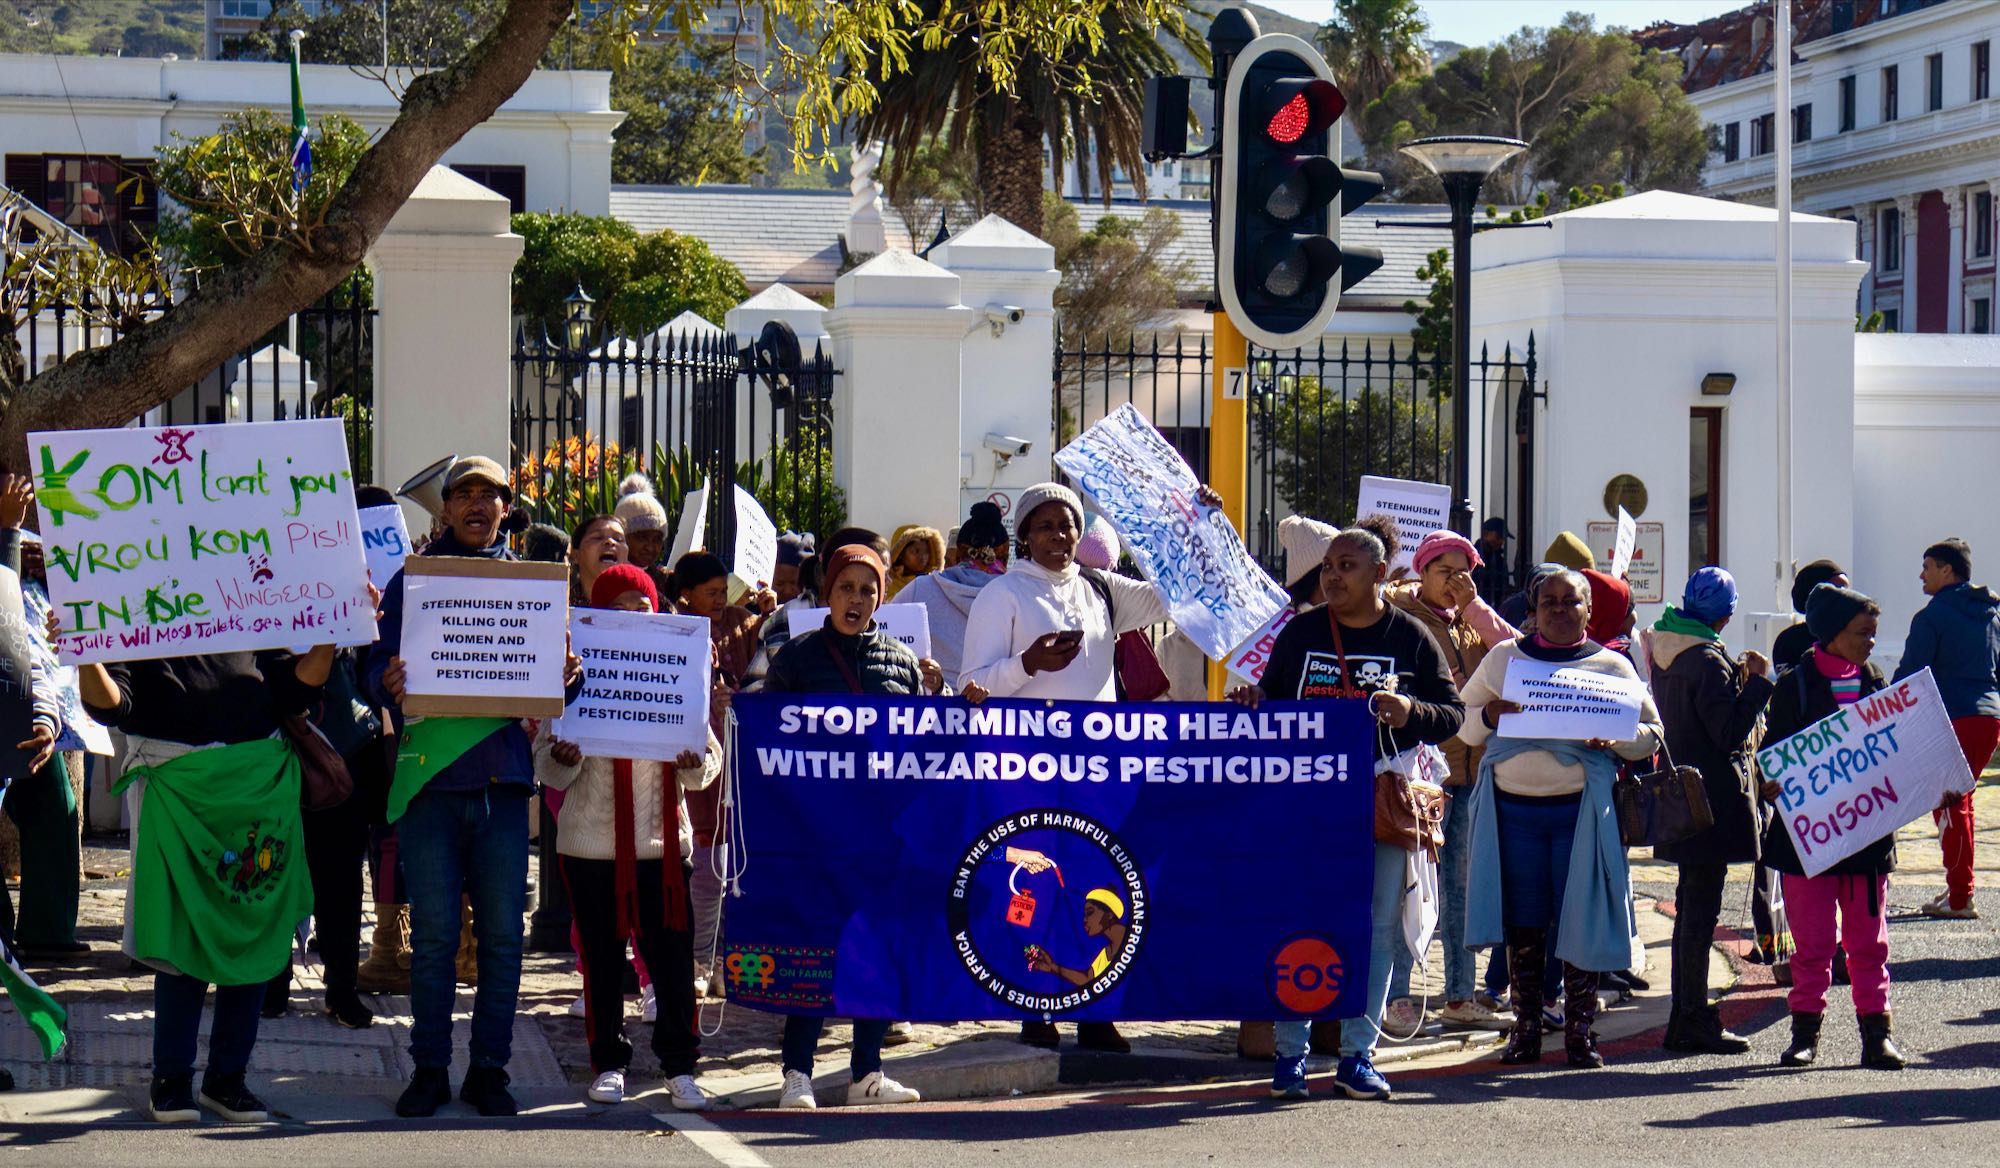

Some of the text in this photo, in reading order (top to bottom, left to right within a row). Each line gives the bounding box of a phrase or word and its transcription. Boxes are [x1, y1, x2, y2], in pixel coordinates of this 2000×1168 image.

[1230, 371, 1242, 396] 7
[36, 445, 183, 526] KOM
[1376, 500, 1440, 516] STEENHUISEN
[1398, 517, 1443, 530] WORKERS
[189, 525, 271, 561] KOM
[62, 595, 130, 634] IN
[216, 577, 335, 612] WINGERD
[421, 600, 551, 611] STEENHUISEN STOP
[442, 616, 528, 628] KILLING OUR
[443, 633, 526, 646] WOMEN AND
[431, 651, 536, 663] CHILDREN WITH
[581, 648, 687, 666] STEENHUISEN
[436, 669, 530, 681] PESTICIDES!!!!
[1310, 660, 1341, 675] Baye
[587, 668, 680, 685] BAN HIGHLY
[1308, 674, 1338, 685] your
[580, 687, 684, 705] HAZARDOUES
[1522, 679, 1628, 696] WORKERS DEMAND
[1528, 691, 1617, 704] PROPER PUBLIC
[579, 707, 685, 725] PESTICIDES!!!!
[1522, 704, 1621, 715] PARTICIPATION!!!!
[779, 705, 1325, 741] STOP HARMING OUR HEALTH
[1759, 683, 1918, 779] EXPORT WINE
[756, 747, 1348, 784] WITH HAZARDOUS PESTICIDES!
[1776, 723, 1900, 813] IS EXPORT
[1793, 776, 1899, 856] POISON
[953, 812, 1145, 1011] BAN THE USE OF HARMFUL EUROPEAN-PRODUCED PESTICIDES IN AFRICA
[779, 967, 833, 979] ON FARMS
